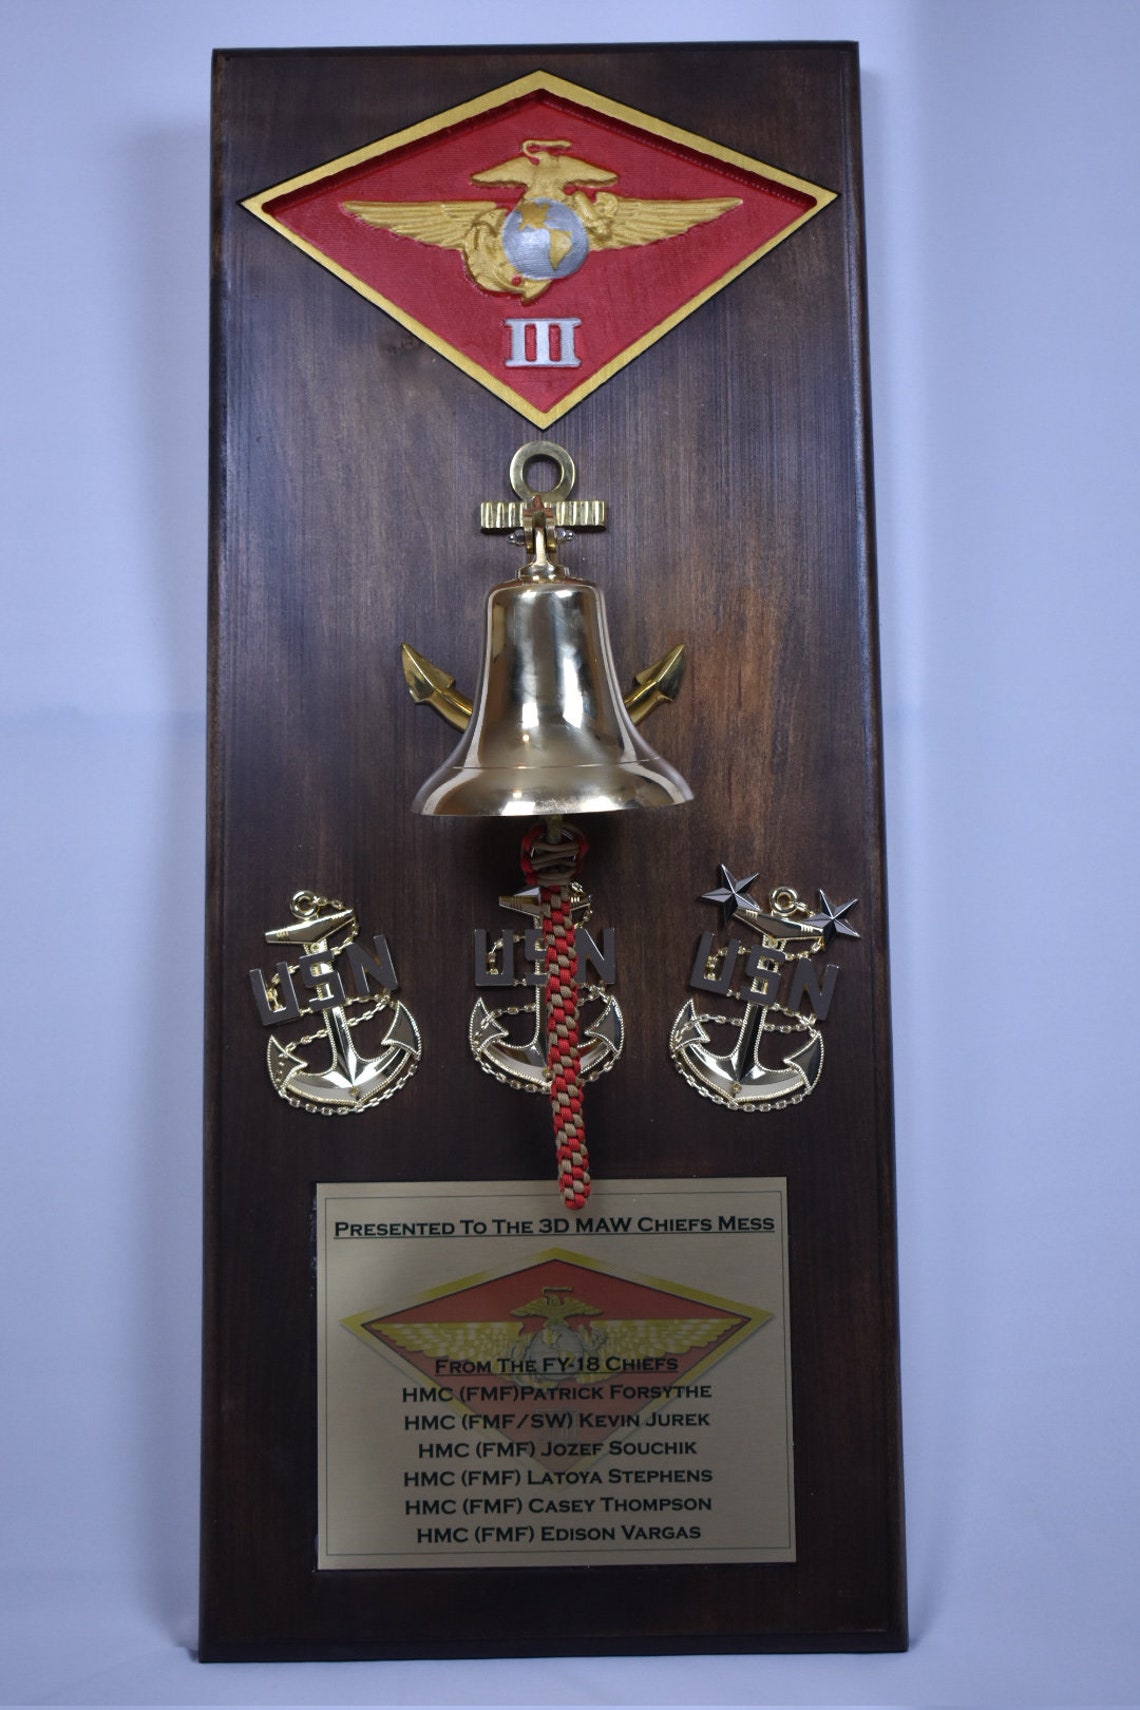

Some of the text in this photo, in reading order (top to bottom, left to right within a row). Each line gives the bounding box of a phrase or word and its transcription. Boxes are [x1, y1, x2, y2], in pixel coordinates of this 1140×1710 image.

[248, 930, 398, 1027] USN
[690, 931, 840, 1020] USN
[334, 1215, 775, 1237] PRESENTED TO THE 3D MAW CHIEFS MESS
[435, 1356, 679, 1374] FROM THE FY-18 CHIEFS
[402, 1386, 454, 1402] HMC
[610, 1384, 712, 1400] FORSYTHE
[404, 1415, 456, 1431] HMC
[461, 1413, 574, 1431] (FMF/SW)
[579, 1413, 640, 1428] KEVIN
[646, 1413, 711, 1428] JUREK
[418, 1441, 697, 1459] HMC (FMF) JOZEF SOUCHIK
[403, 1469, 713, 1487] HMC (FMF) LATOYA STEPHENS
[405, 1497, 712, 1515] HMC (FMF) CASEY THOMPSON
[417, 1525, 701, 1543] HMC (FMF) EDISON VARGAS
